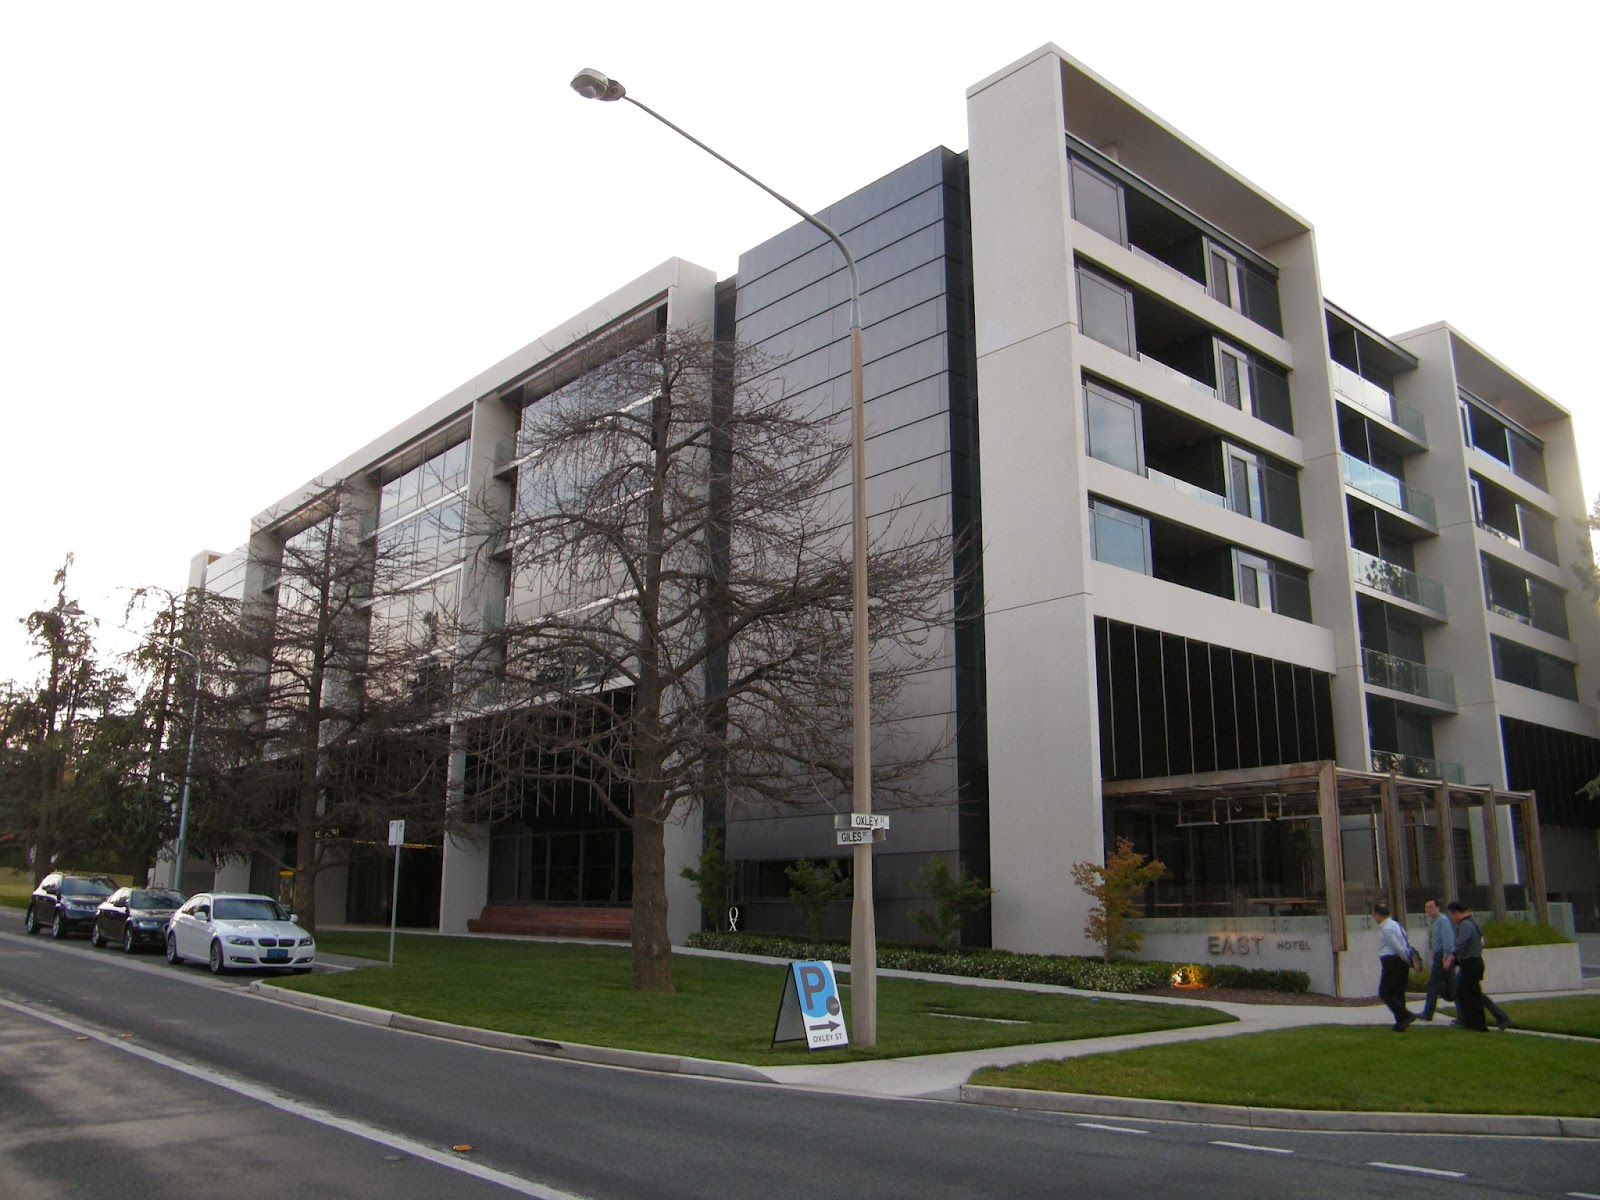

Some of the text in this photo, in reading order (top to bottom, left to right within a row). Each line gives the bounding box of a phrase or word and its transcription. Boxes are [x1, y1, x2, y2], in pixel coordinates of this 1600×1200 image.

[855, 815, 879, 826] OXLEY
[841, 831, 862, 842] GILES
[1208, 935, 1311, 955] EAST HOTEL
[799, 966, 826, 1010] P
[812, 1034, 833, 1043] OXLEY
